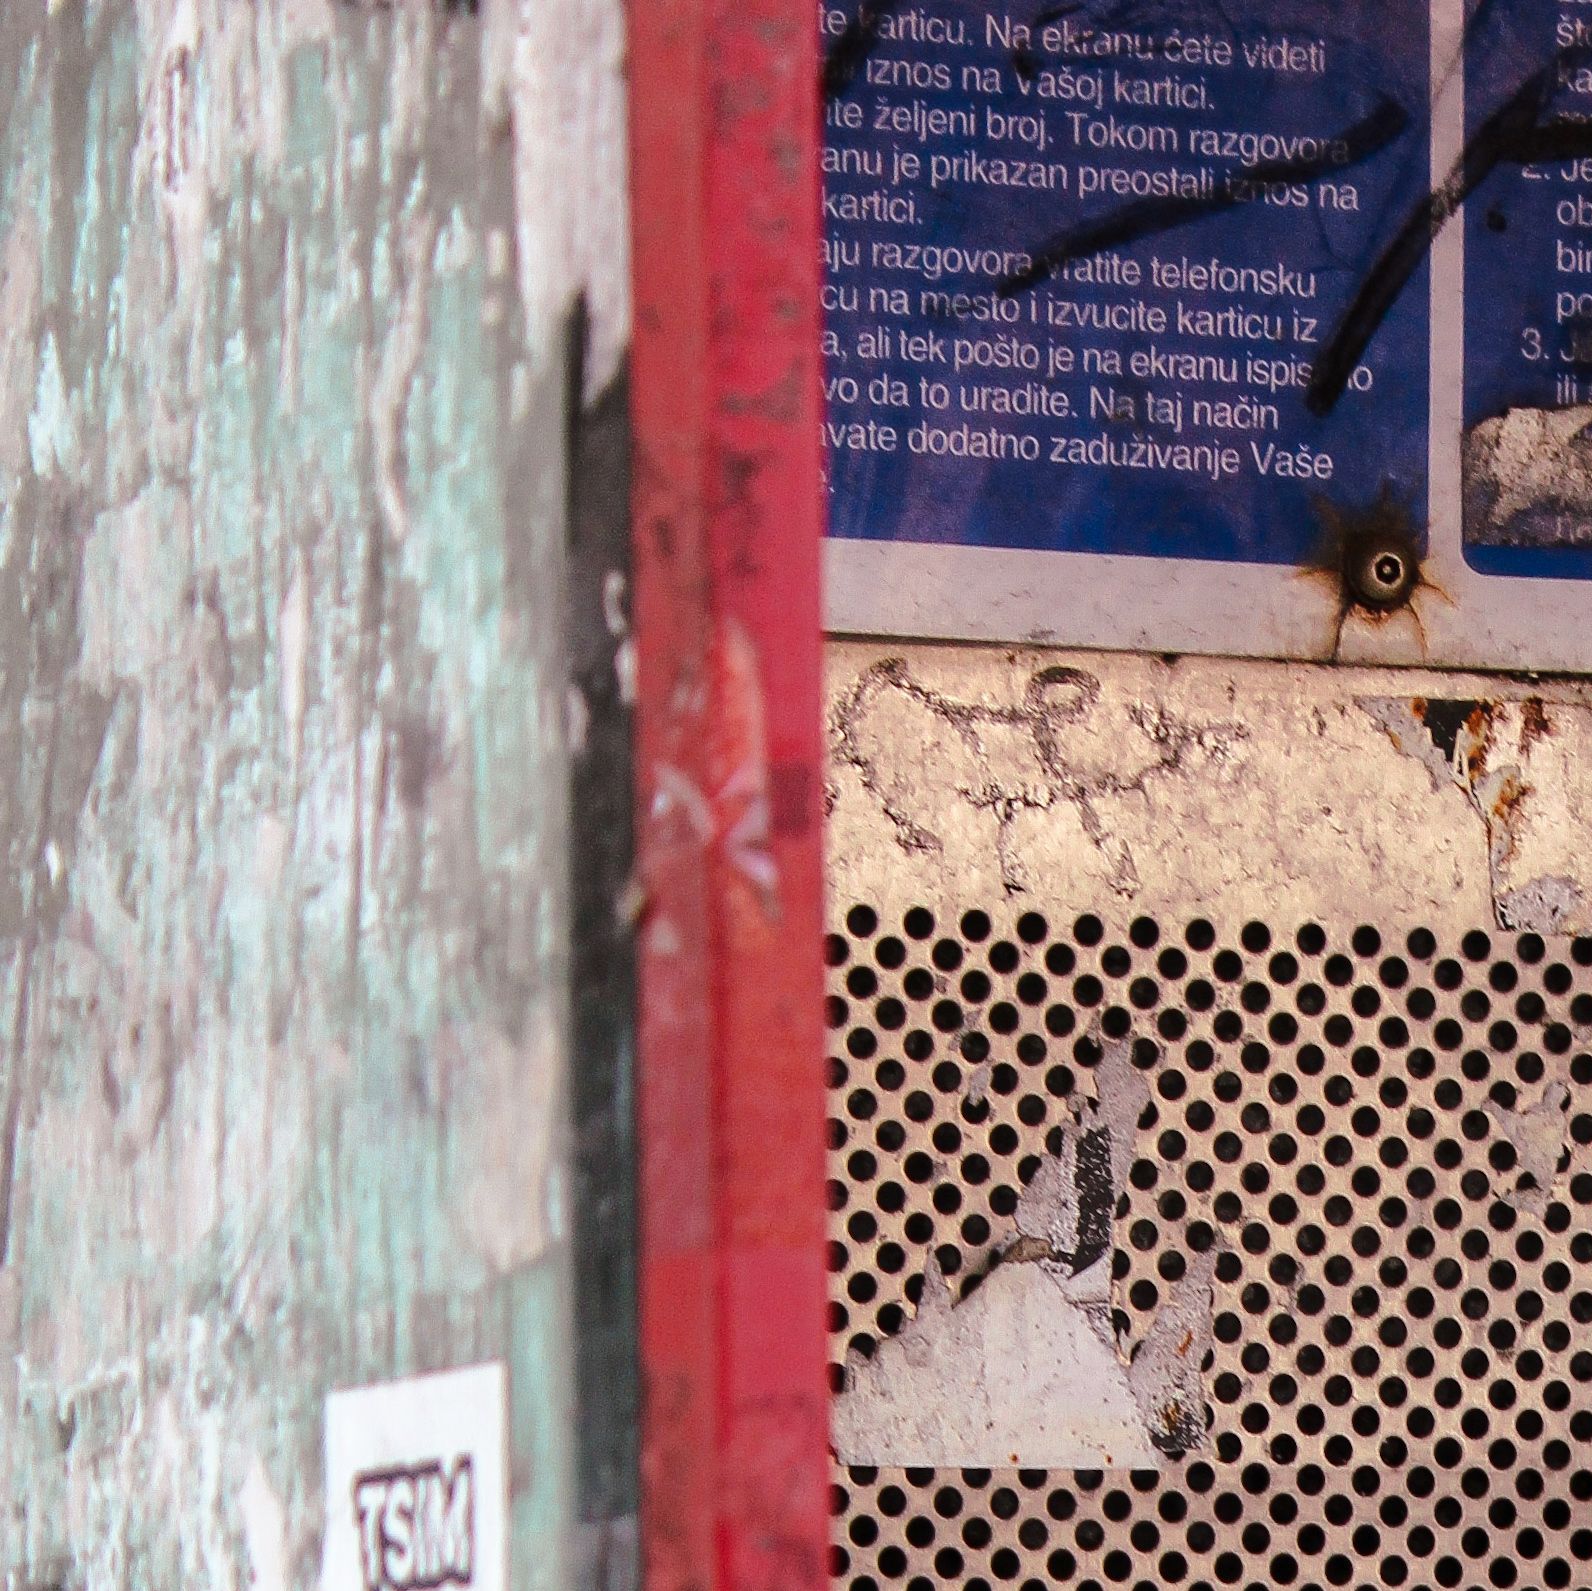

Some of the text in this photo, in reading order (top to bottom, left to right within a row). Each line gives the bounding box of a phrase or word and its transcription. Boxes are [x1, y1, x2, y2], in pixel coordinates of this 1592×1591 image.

[985, 13, 1032, 50] Na
[1042, 21, 1153, 59] ekranu
[1164, 28, 1233, 65] ćete
[1242, 37, 1326, 73] videti
[961, 65, 1002, 94] na
[1113, 70, 1215, 109] kartici.
[872, 96, 976, 142] željeni
[986, 105, 1053, 151] broj.
[1065, 111, 1178, 152] Tokom
[1189, 128, 1350, 166] razgovora
[820, 146, 882, 176] anu
[892, 145, 920, 186] je
[930, 150, 1067, 189] prikazan
[1079, 166, 1214, 200] preostali
[1319, 182, 1359, 212] na
[820, 186, 923, 225] kartici.
[871, 239, 1033, 280] razgovora
[1151, 256, 1316, 298] telefonsku
[819, 285, 1318, 342] cu na mesto i izvucite karticu iz
[821, 326, 1374, 393] a, ali tek pošto je na ekranu ispiso
[1521, 328, 1549, 361] 3.
[822, 373, 1279, 433] vo da to uradite. Na taj način
[1557, 373, 1576, 404] ili
[821, 420, 1334, 480] vate dodatno zaduživanje Vaše
